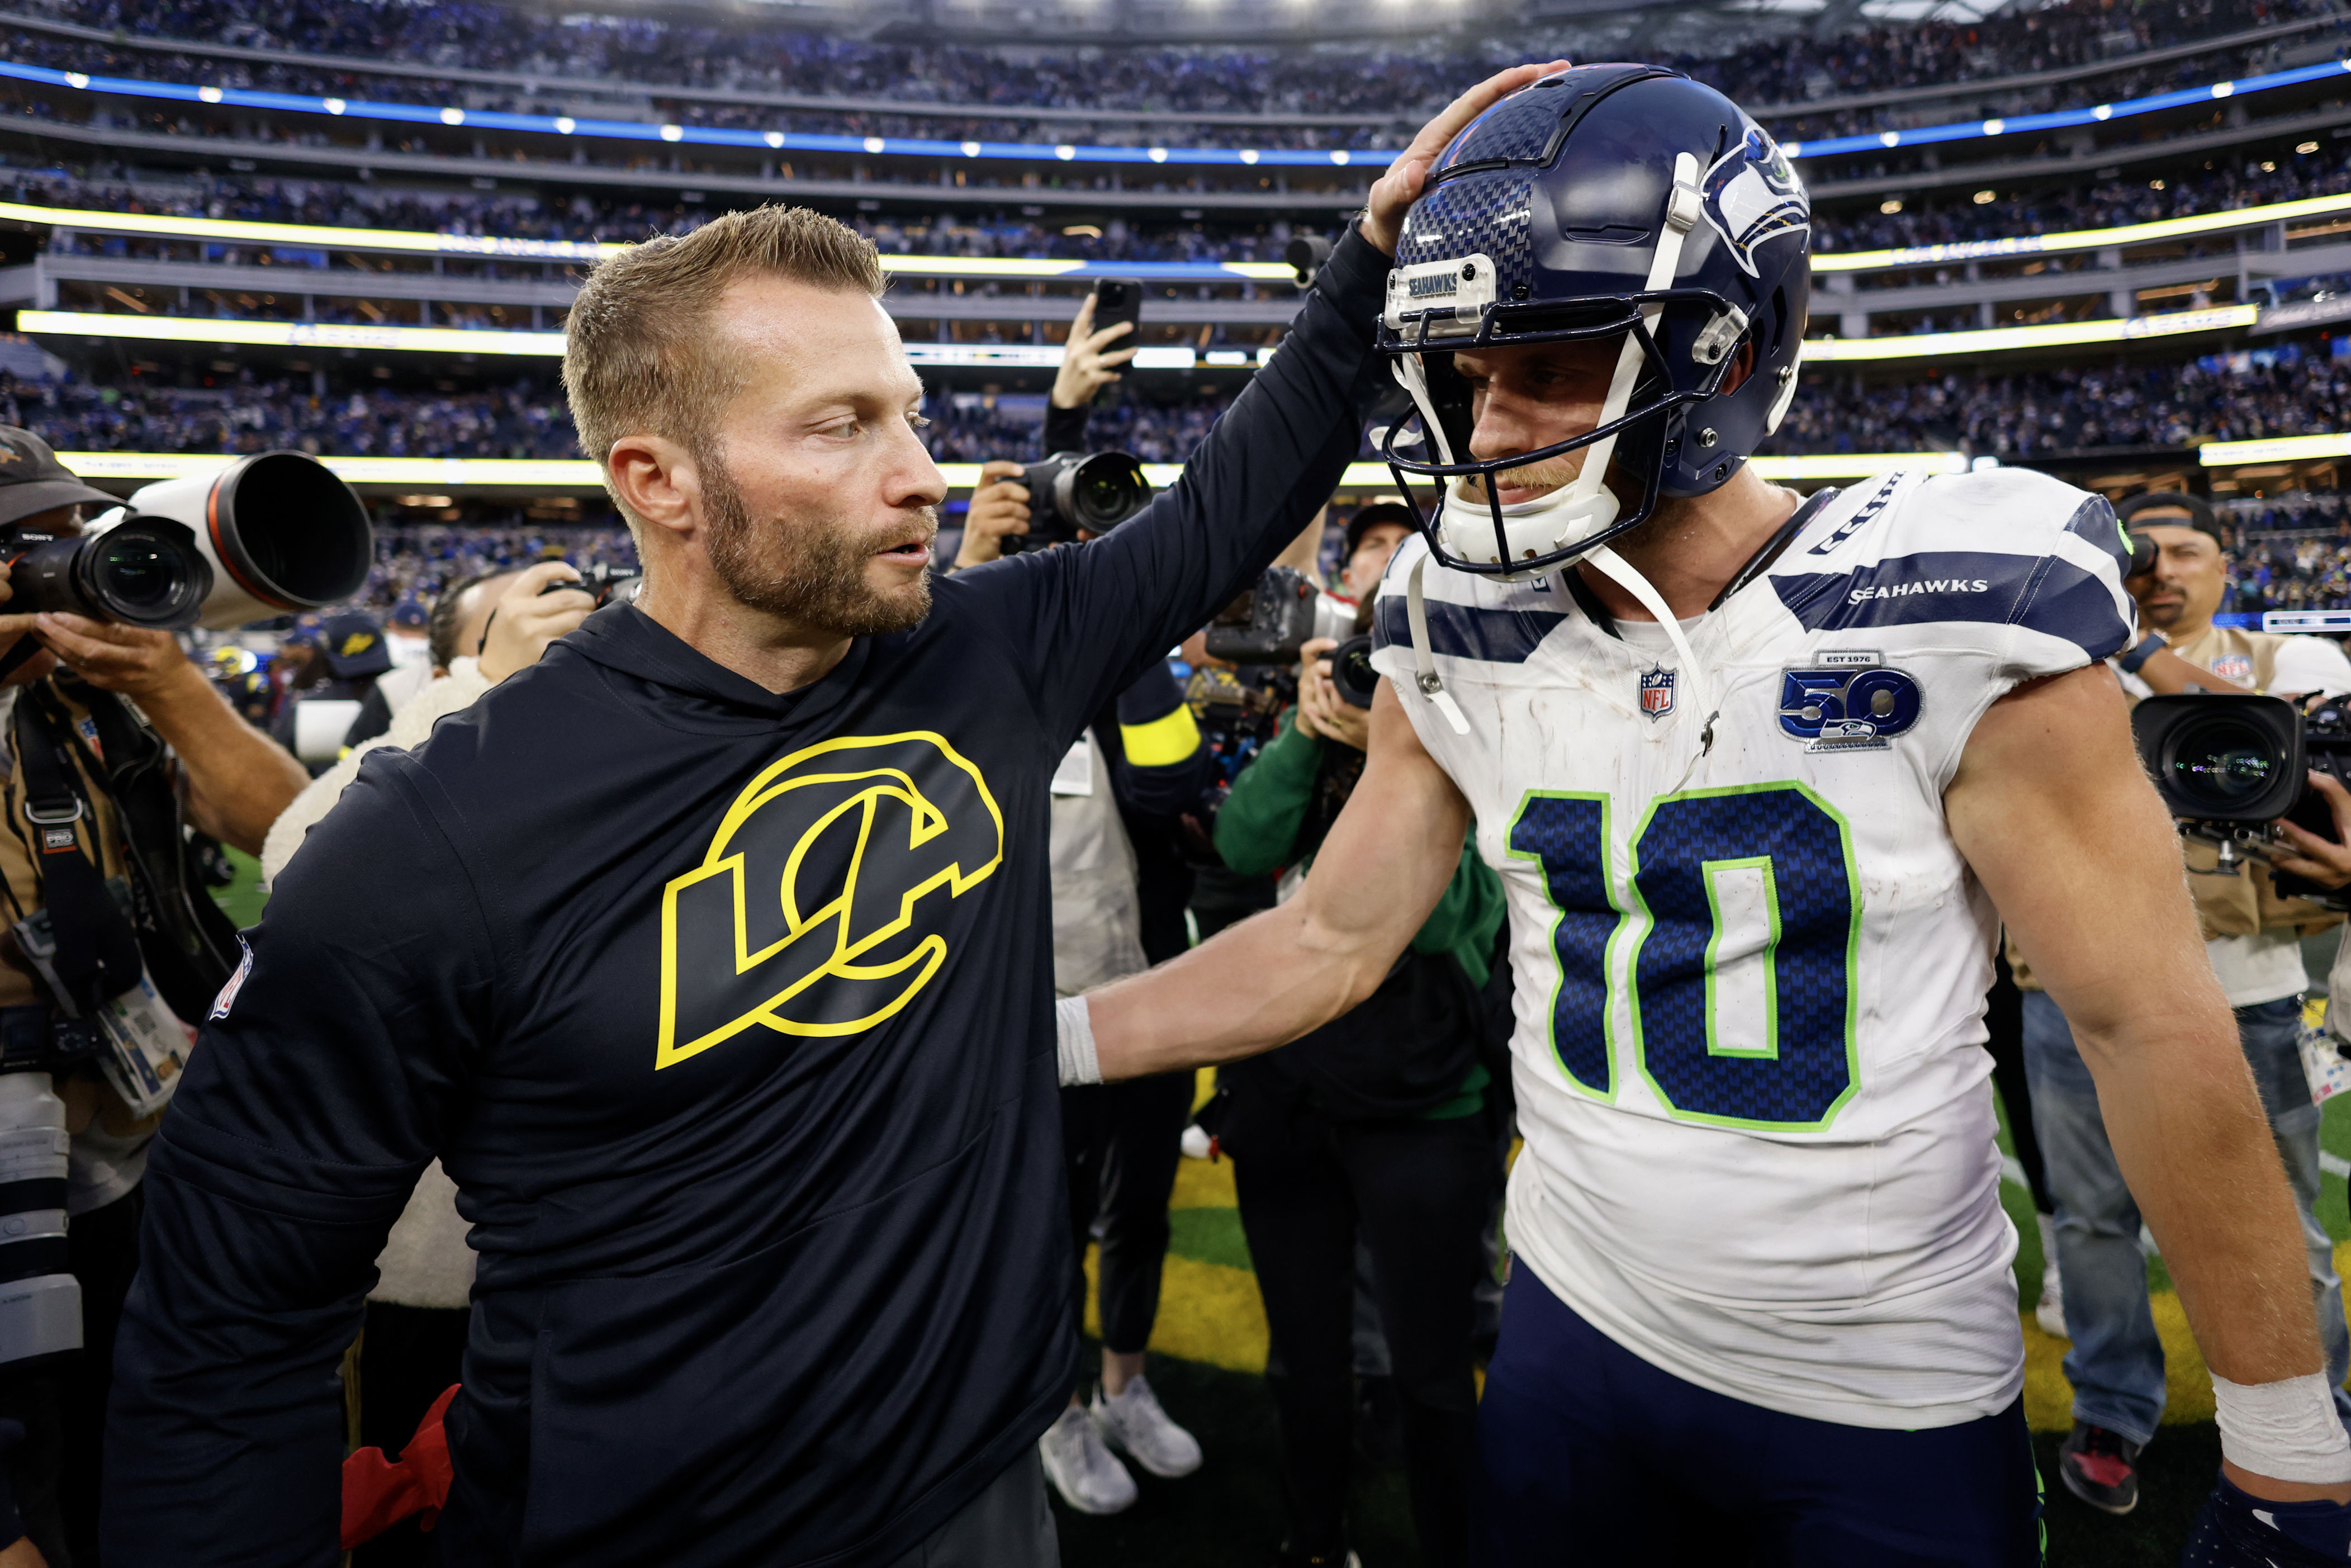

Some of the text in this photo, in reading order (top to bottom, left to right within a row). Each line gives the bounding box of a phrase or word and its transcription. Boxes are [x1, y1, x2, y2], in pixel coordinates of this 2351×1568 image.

[1409, 273, 1457, 296] SEAHAWKS
[1848, 579, 1988, 605] SEAHAWKS
[2216, 661, 2249, 675] NFL
[1642, 689, 1670, 711] NFL
[1780, 669, 1921, 737] 50
[1505, 780, 1862, 1133] 10
